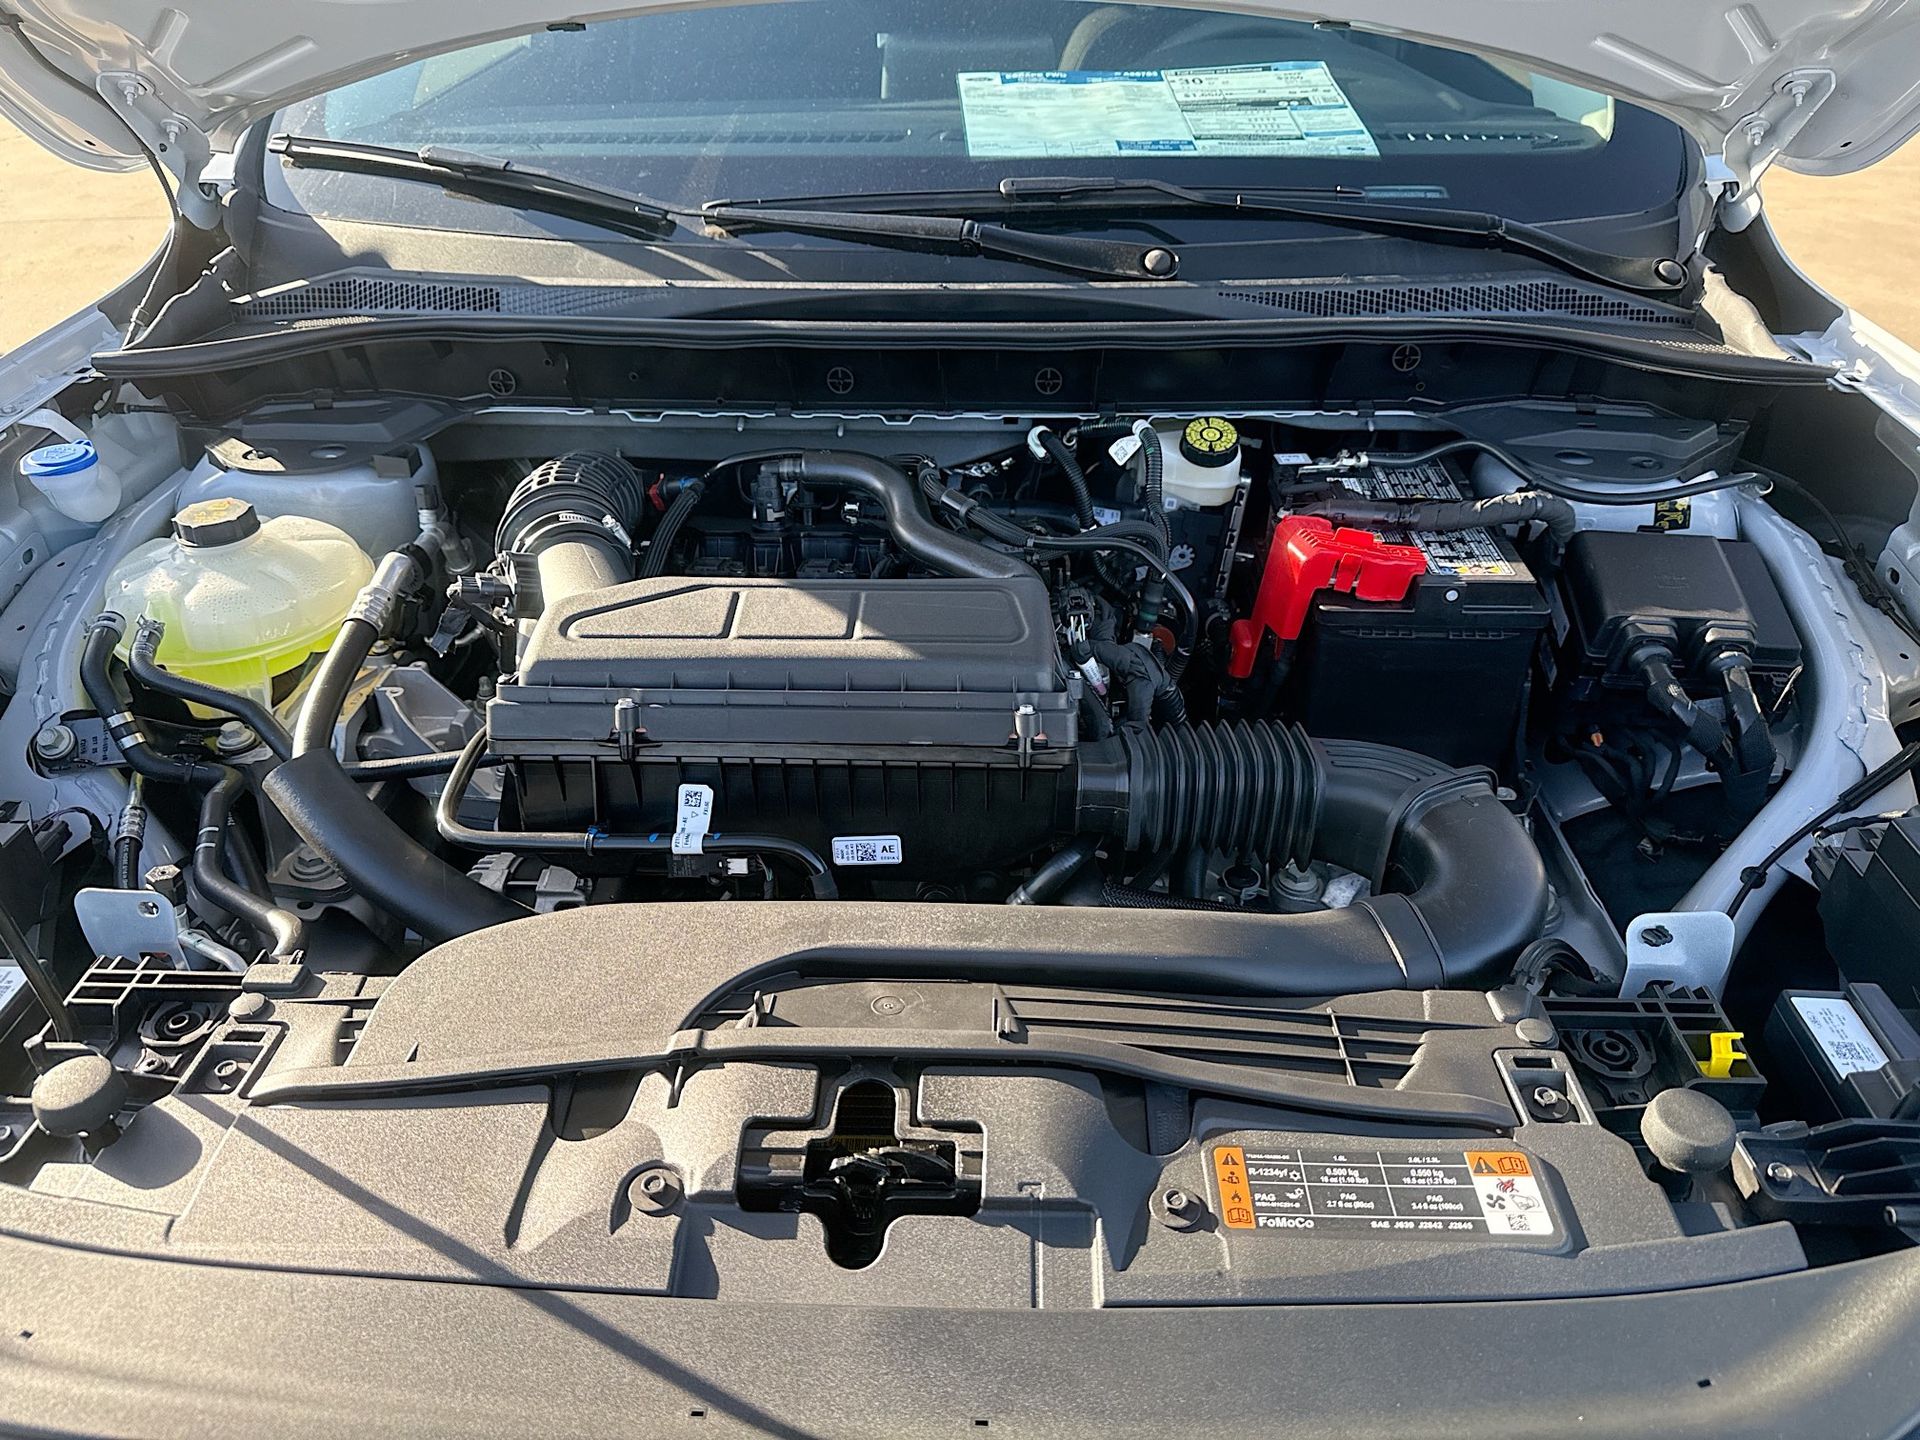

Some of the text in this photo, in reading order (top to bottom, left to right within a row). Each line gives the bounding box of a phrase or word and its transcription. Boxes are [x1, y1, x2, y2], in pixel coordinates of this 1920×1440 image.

[881, 844, 896, 854] AE
[1347, 1168, 1360, 1177] kg
[1432, 1169, 1444, 1178] kg
[1254, 1193, 1277, 1201] PAG
[1258, 1216, 1315, 1229] FoMoCo
